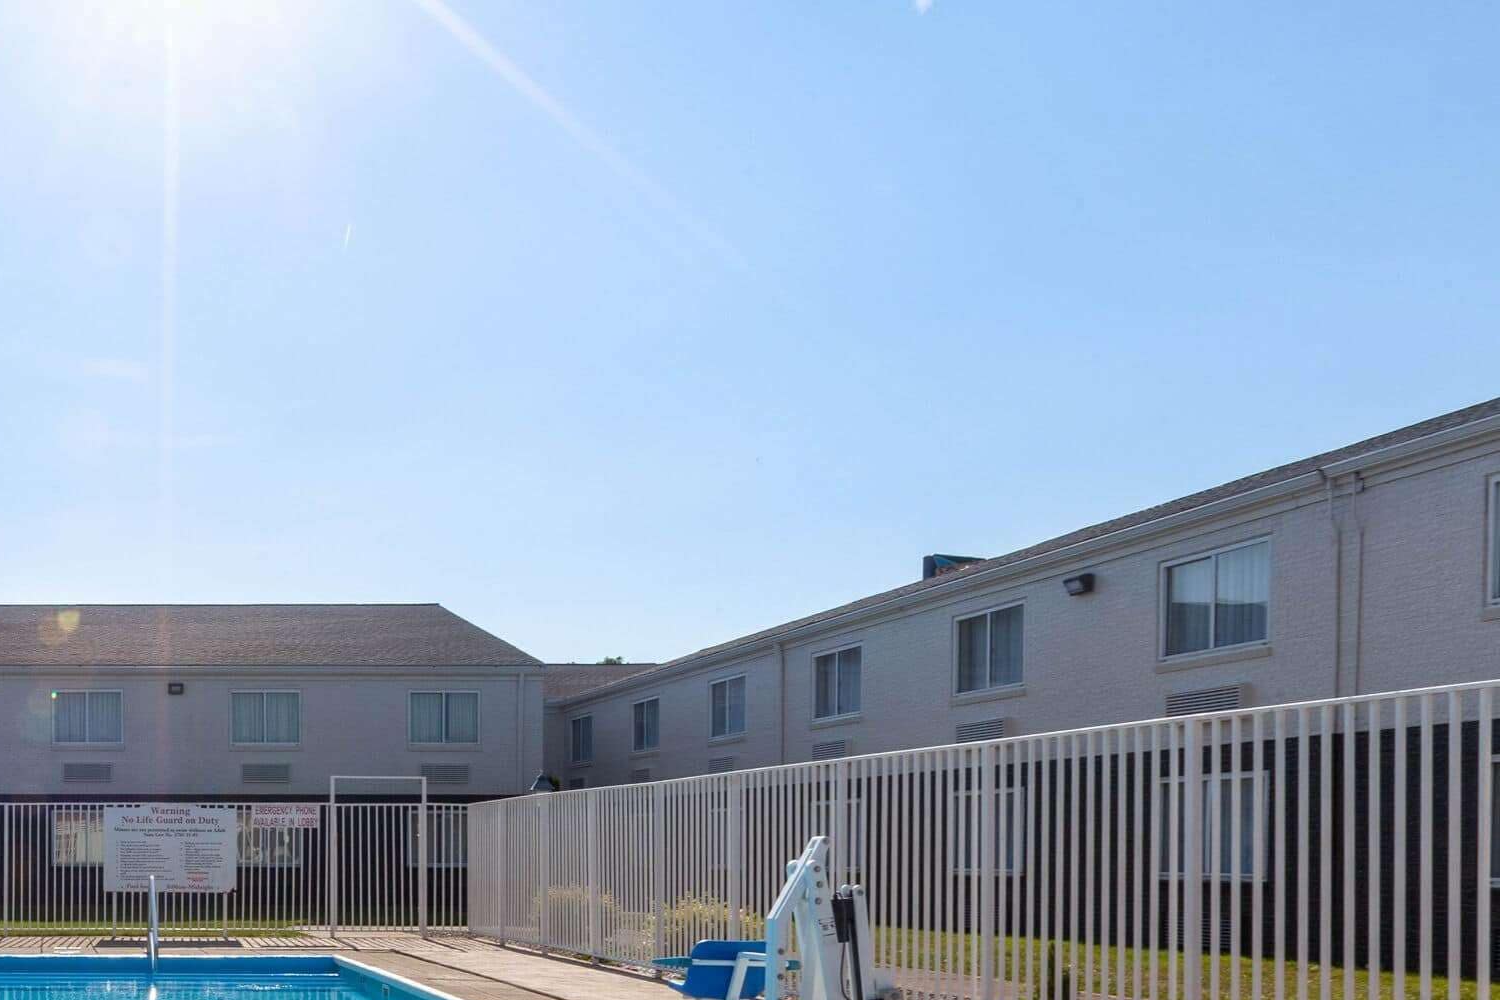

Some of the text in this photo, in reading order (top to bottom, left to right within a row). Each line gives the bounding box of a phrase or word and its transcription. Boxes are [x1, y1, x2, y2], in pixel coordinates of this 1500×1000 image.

[151, 807, 191, 816] Warning
[254, 806, 317, 815] EMERGENCY PHONE
[121, 816, 134, 825] No
[136, 816, 153, 825] Life
[156, 816, 183, 825] Guard
[198, 816, 219, 827] Duty
[253, 816, 287, 827] AVAILABLE
[297, 816, 317, 827] LOBBY
